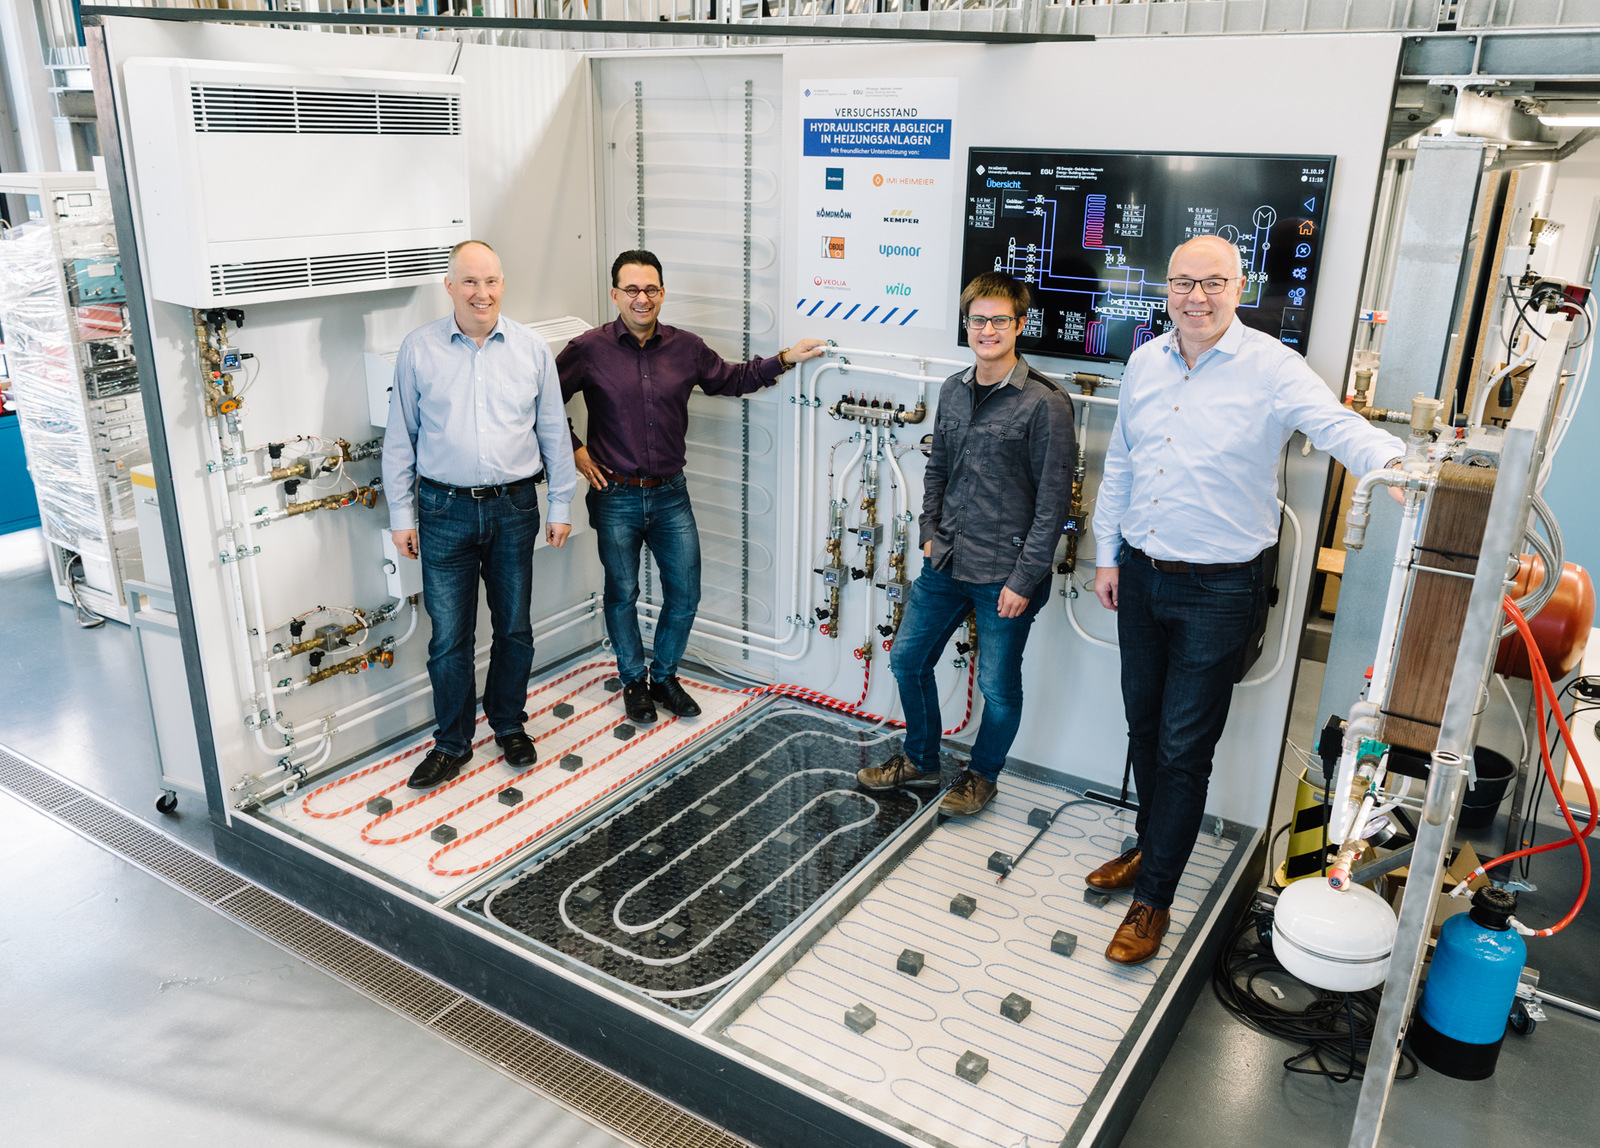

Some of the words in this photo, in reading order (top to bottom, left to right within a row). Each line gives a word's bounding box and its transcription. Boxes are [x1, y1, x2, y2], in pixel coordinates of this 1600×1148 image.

[835, 108, 918, 117] VERSUCHSSTAND
[810, 122, 890, 133] HYDRAULISCHER
[892, 123, 944, 133] ABGLEICH
[821, 134, 832, 144] IN
[834, 135, 931, 145] HEIZUNGSANLAGEN
[870, 148, 907, 156] Unterstützung
[986, 177, 1021, 189] Übersicht
[822, 236, 844, 258] KOBOLD
[879, 244, 921, 258] uponor
[885, 283, 911, 296] wilo
[1282, 336, 1299, 344] Details
